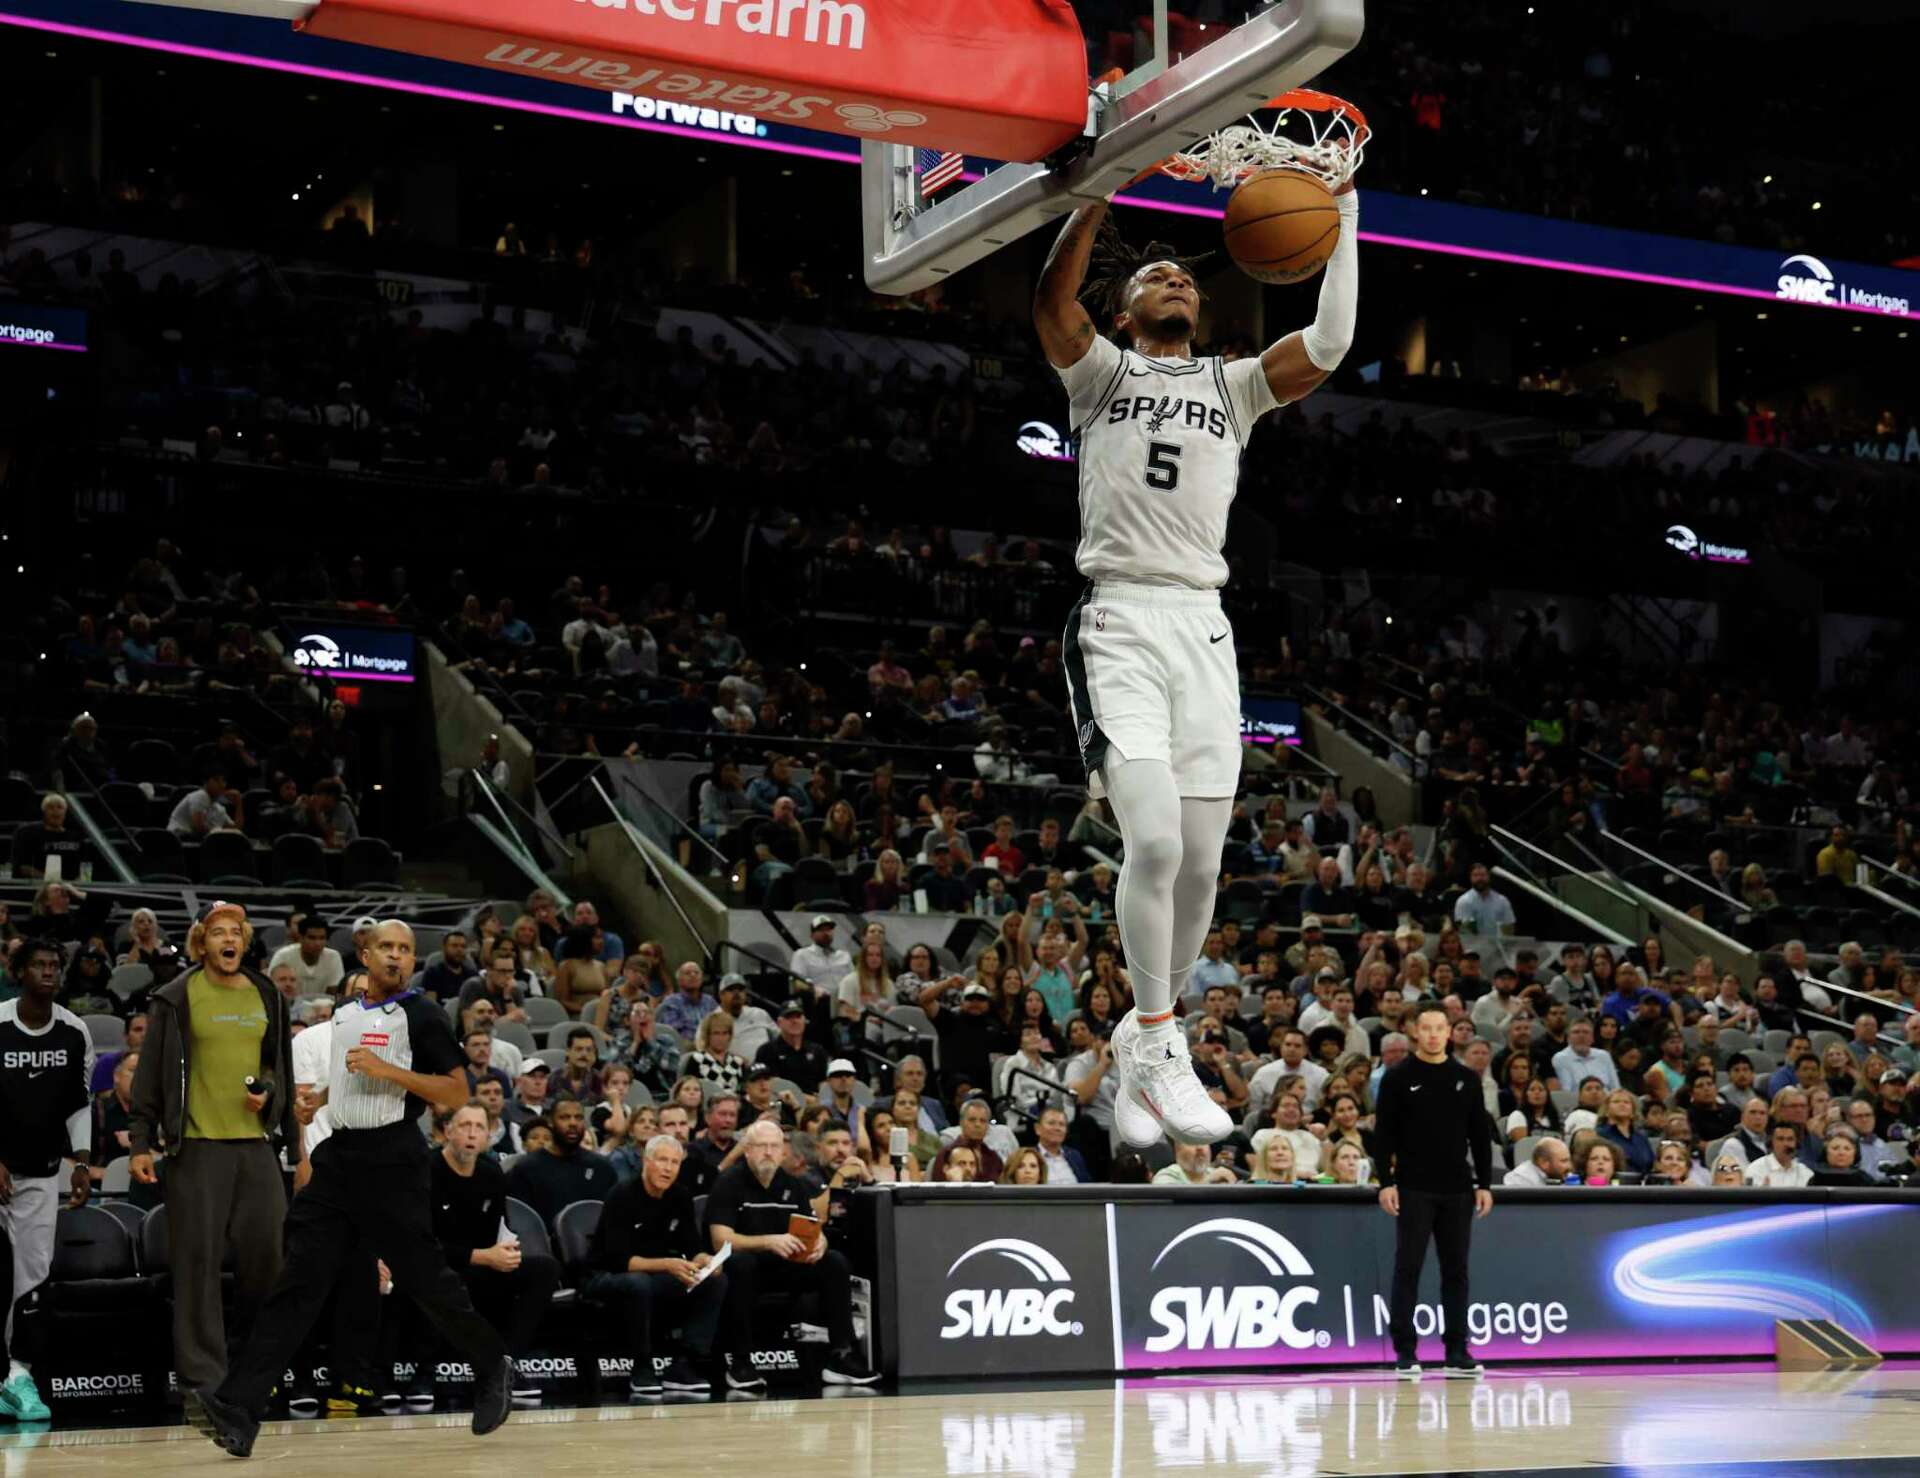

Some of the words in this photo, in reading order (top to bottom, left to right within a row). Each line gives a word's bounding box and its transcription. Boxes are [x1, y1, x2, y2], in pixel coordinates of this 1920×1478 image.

[484, 43, 833, 119] StateFarm
[1776, 275, 1837, 305] SWBC
[1108, 395, 1227, 440] SPURS
[1143, 440, 1183, 493] 5
[352, 654, 408, 672] Mortgage
[4, 1049, 68, 1069] SPURS
[1373, 1294, 1569, 1346] Mogage
[51, 1374, 144, 1391] BARCODE
